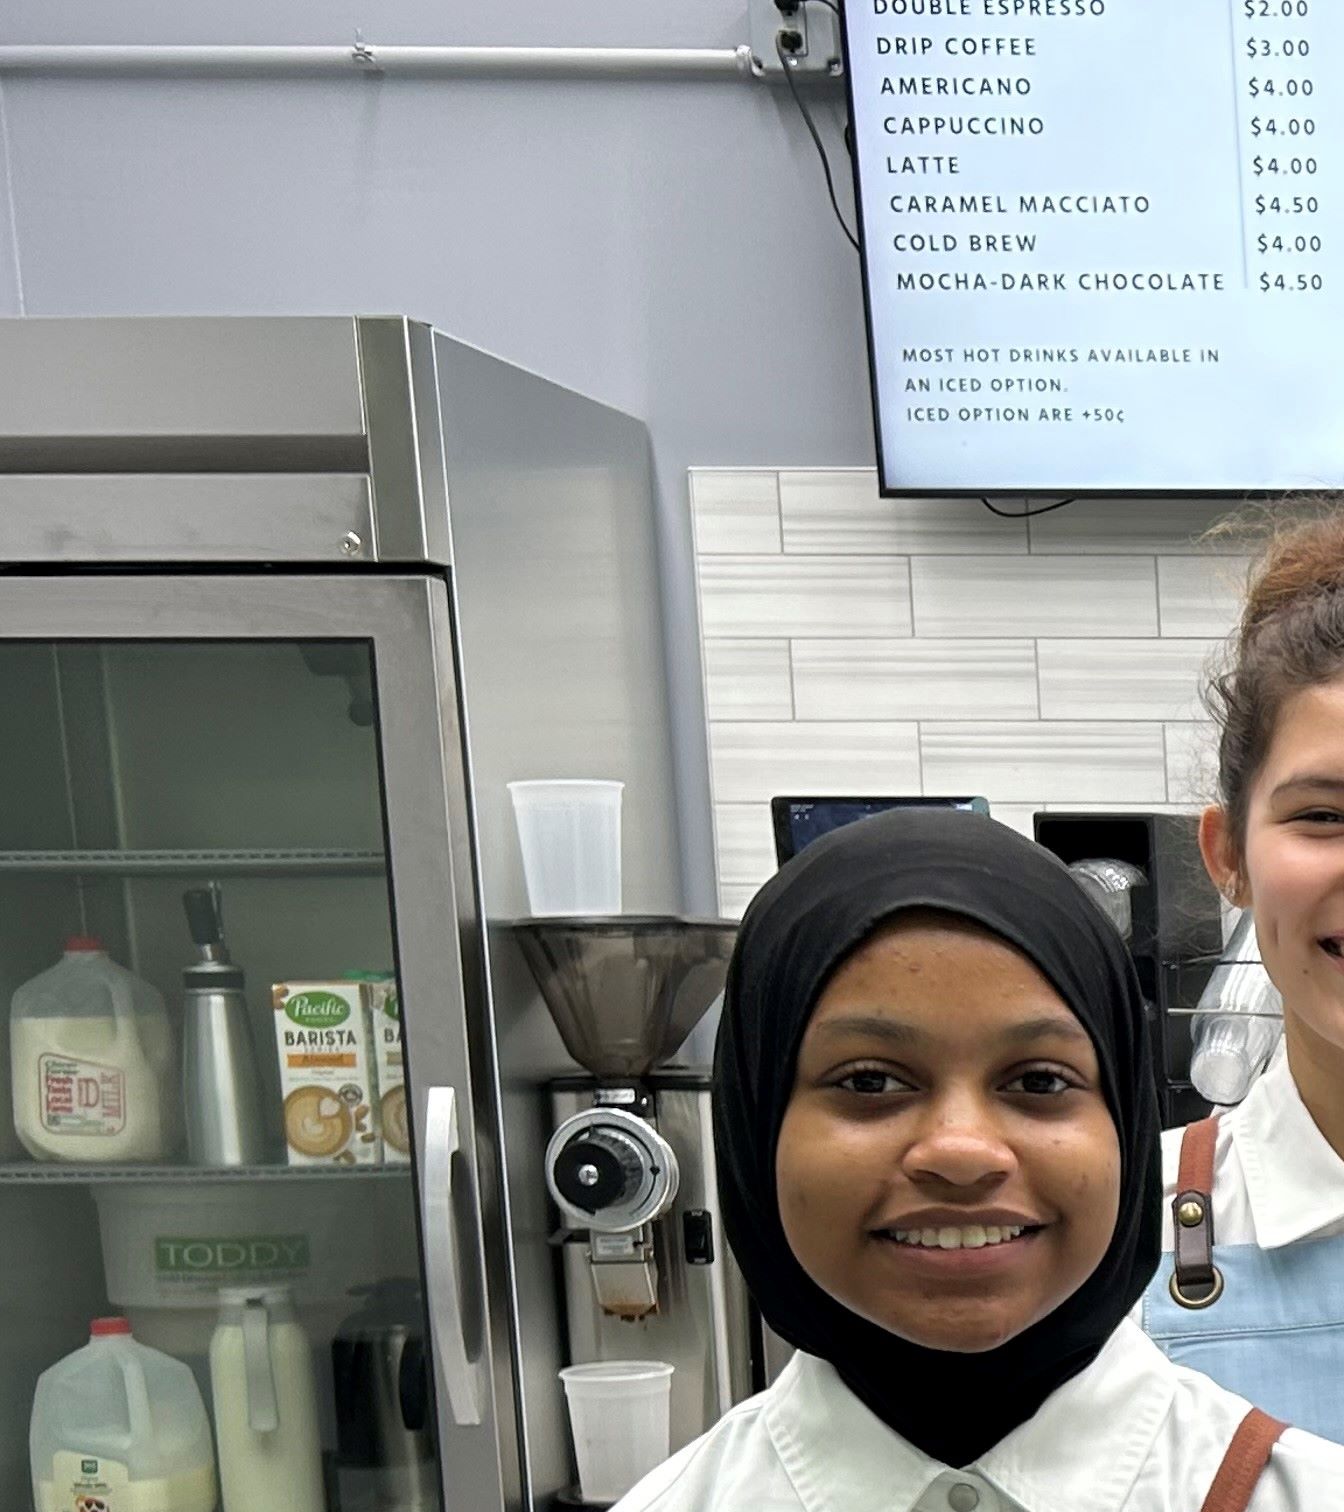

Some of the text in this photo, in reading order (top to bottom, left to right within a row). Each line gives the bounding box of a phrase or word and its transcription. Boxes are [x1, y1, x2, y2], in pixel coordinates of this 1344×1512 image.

[874, 0, 1104, 16] DOUBLE ESPRESSO
[1245, 0, 1307, 19] $2.00
[877, 37, 1035, 55] DRIP COFFEE
[1247, 37, 1309, 58] $3.00
[881, 77, 1030, 95] AMERICANO
[1249, 77, 1313, 98] $4.00
[884, 117, 1043, 134] CAPPUCCINO
[1251, 116, 1315, 137] $4.00
[887, 157, 959, 174] LATTE
[1253, 155, 1317, 176] $4.00
[890, 196, 1149, 213] CARAMEL MACCIATO
[1255, 194, 1318, 215] $4.50
[894, 234, 1036, 251] COLD BREW
[1258, 233, 1321, 254] $4.00
[897, 273, 1223, 290] MOCHA-DARK CHOCOLATE
[1260, 272, 1322, 292] $4.50
[903, 349, 1218, 362] MOST HOT DRINKS AVAILABLE IN
[905, 378, 930, 392] AN
[940, 378, 981, 392] ICED
[907, 408, 949, 421] ICED
[958, 408, 1028, 421] OPTION
[1039, 408, 1072, 421] ARE
[291, 995, 345, 1016] Pacific
[284, 1030, 357, 1046] BARISTA
[160, 1242, 304, 1268] TODDY
